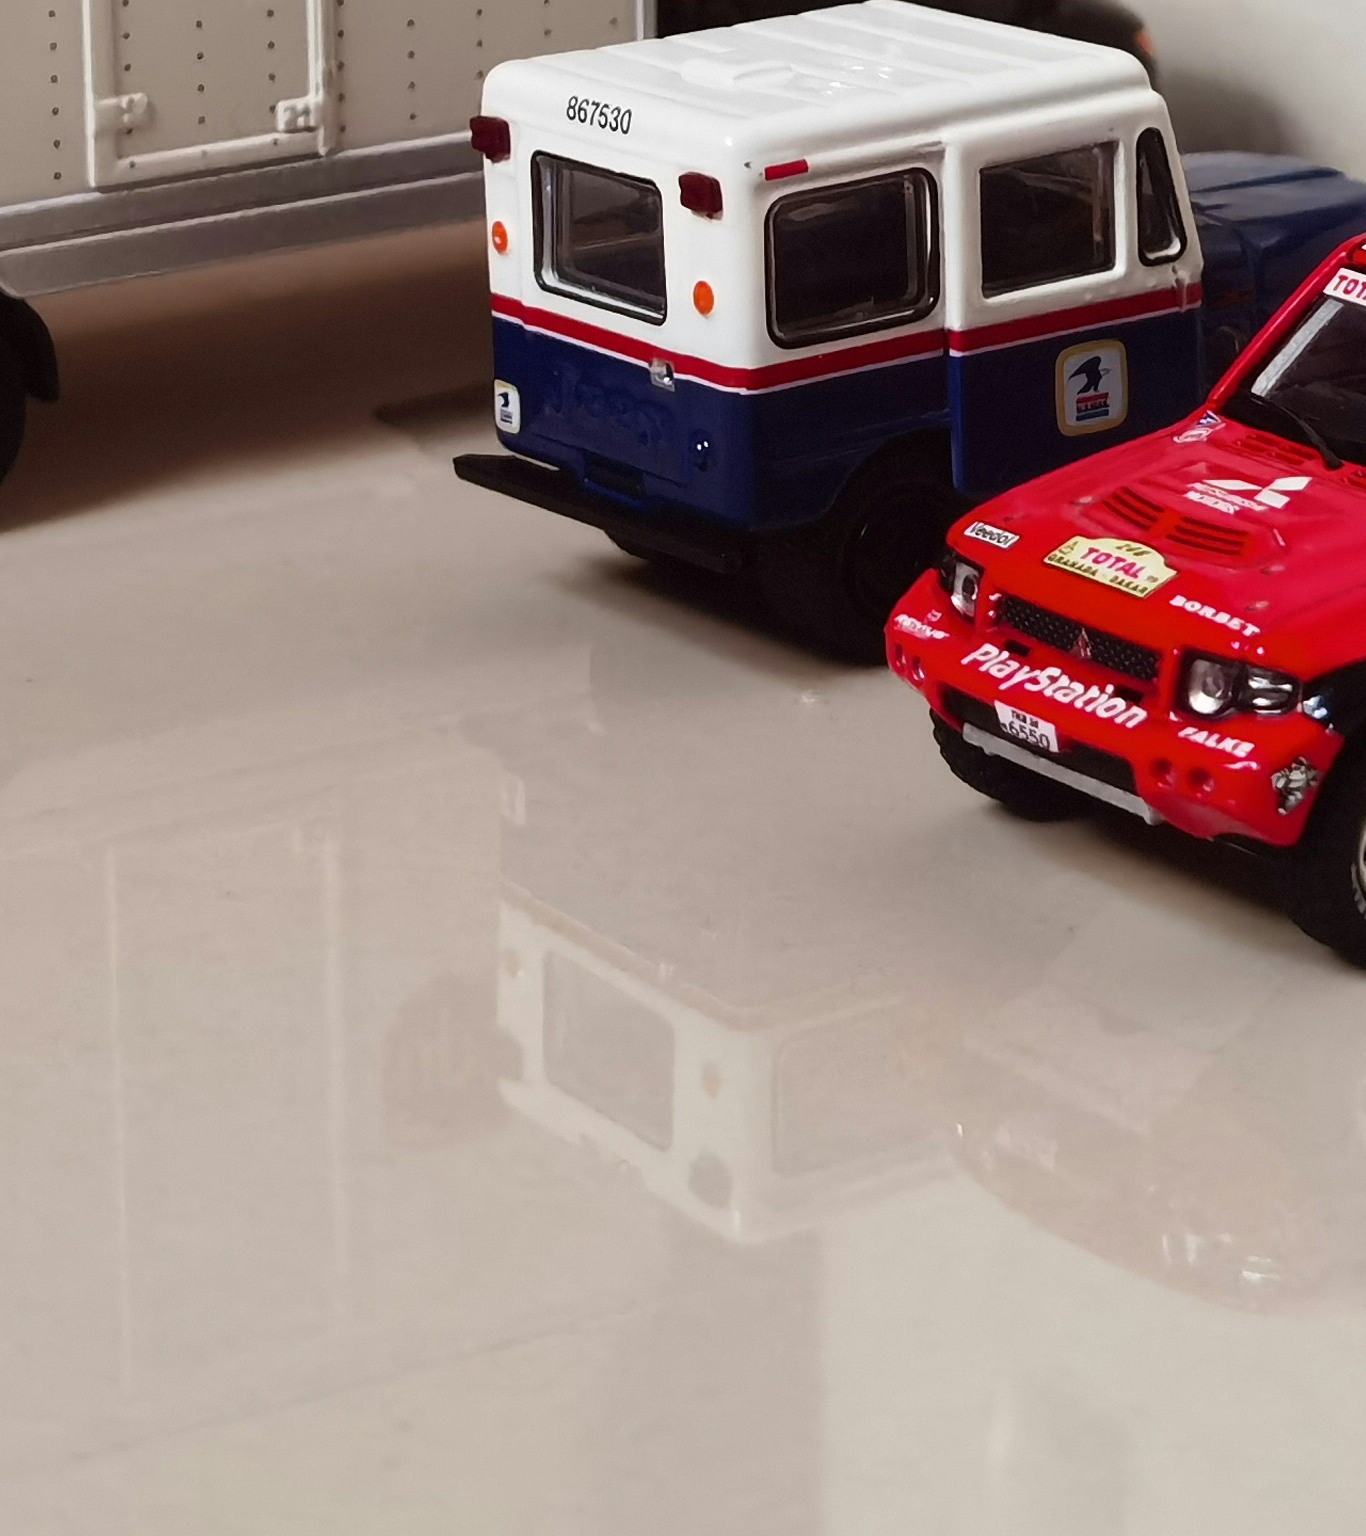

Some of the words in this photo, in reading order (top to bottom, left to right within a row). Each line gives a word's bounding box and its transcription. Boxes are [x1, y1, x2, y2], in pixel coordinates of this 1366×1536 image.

[566, 95, 633, 135] 867530
[1080, 547, 1147, 580] TOTAL
[1169, 594, 1261, 638] BORBET
[961, 642, 1149, 730] PlayStation
